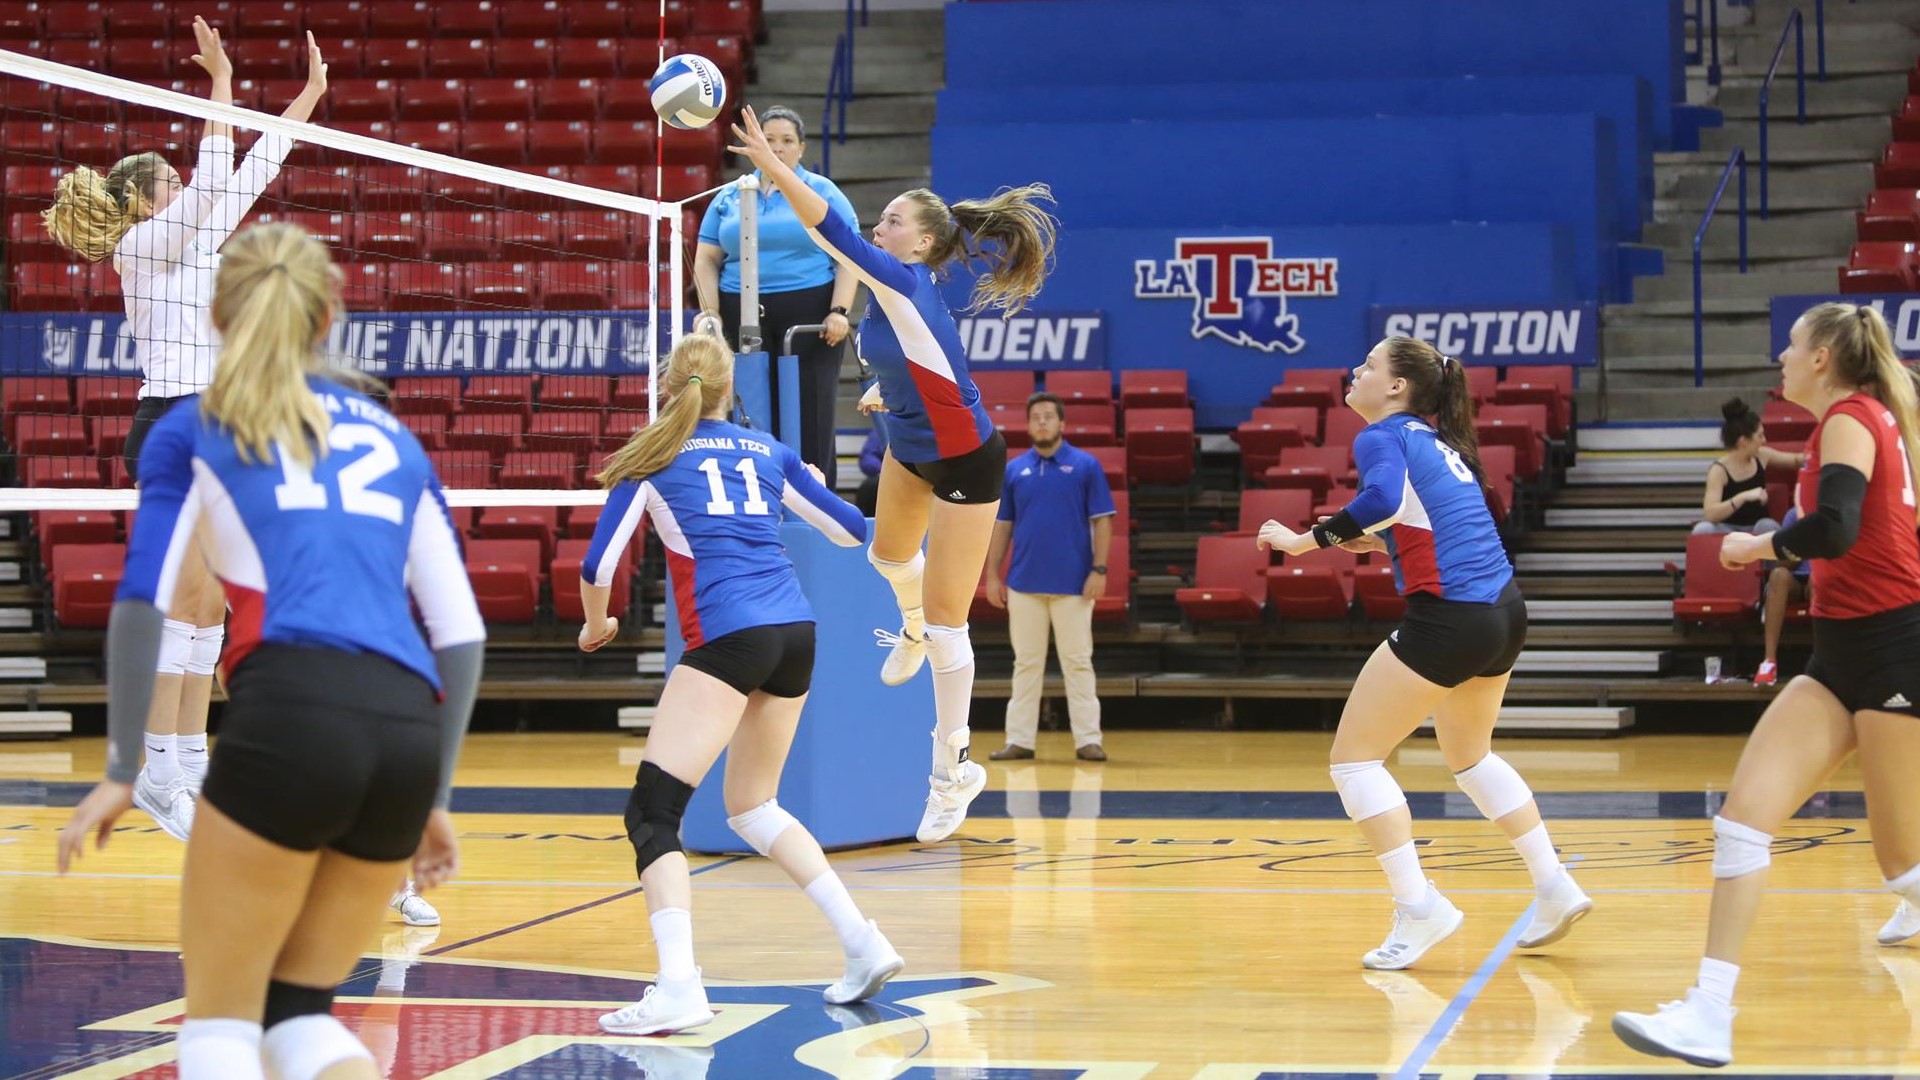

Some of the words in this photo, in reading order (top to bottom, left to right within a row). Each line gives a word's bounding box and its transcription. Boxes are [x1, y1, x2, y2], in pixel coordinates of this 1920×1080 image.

[690, 58, 713, 97] molten
[403, 317, 612, 372] NATION
[1384, 309, 1582, 356] SECTION
[738, 438, 771, 458] TECH
[1434, 438, 1474, 483] 8
[273, 422, 404, 526] 12
[697, 457, 770, 515] 11
